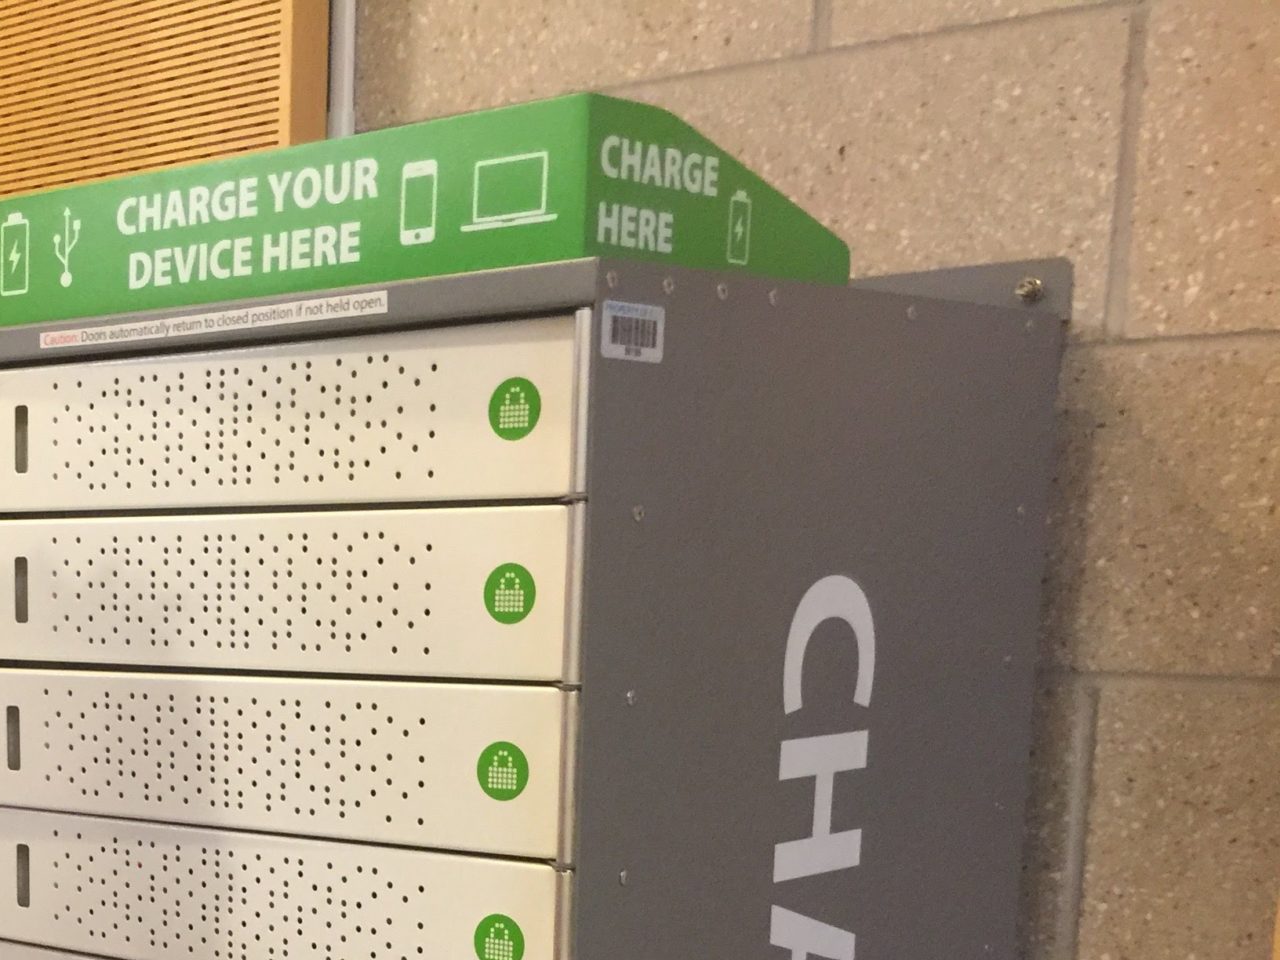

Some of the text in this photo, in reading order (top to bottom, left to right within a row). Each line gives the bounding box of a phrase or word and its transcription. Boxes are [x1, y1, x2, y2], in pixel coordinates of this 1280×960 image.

[116, 157, 379, 236] CHARGE YOUR
[599, 134, 720, 197] CHARGE
[127, 221, 361, 290] DEVICE HERE
[596, 200, 674, 254] HERE
[80, 330, 108, 343] Doors
[108, 318, 172, 339] automatically
[172, 319, 202, 333] return
[204, 317, 214, 329] to
[216, 311, 249, 327] closed
[251, 308, 293, 326] position
[295, 304, 303, 317] if
[305, 304, 324, 317] not
[326, 300, 350, 314] held
[352, 297, 385, 313] open.
